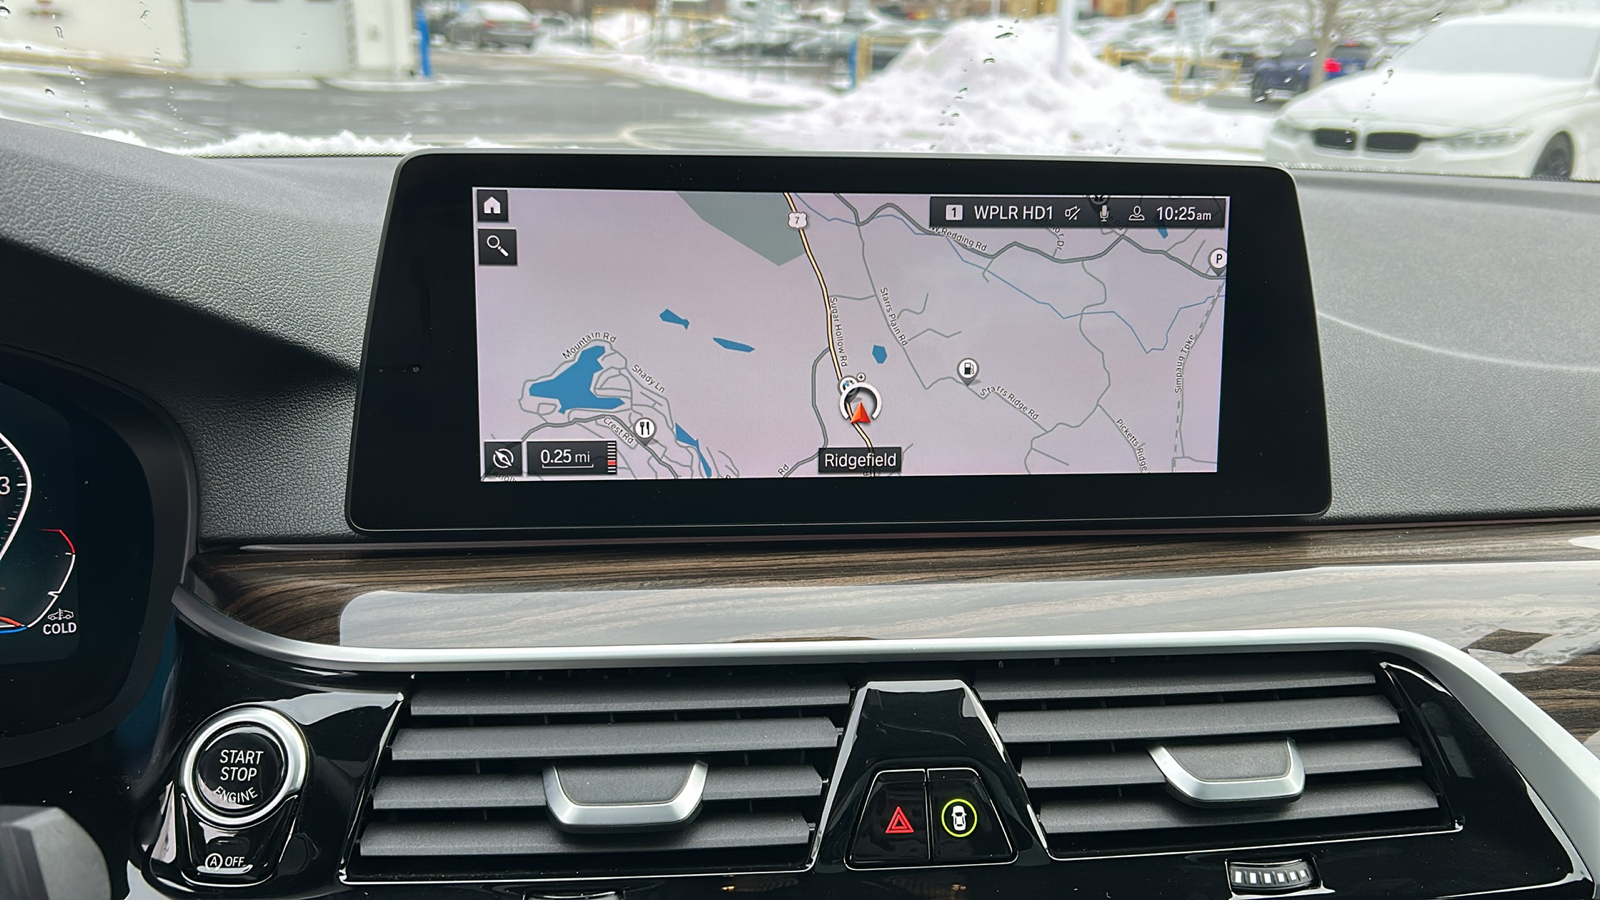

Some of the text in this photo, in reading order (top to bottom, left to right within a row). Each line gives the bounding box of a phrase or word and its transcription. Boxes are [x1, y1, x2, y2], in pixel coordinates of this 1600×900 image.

[794, 216, 800, 224] 7
[974, 205, 1053, 220] WPLR HD1
[941, 227, 974, 248] Redding
[975, 241, 988, 252] Rd
[880, 287, 908, 346] Starrs Plain Rd
[830, 297, 848, 367] Sugar Hollow Rd
[562, 332, 617, 359] Mountain Rd
[1174, 334, 1195, 394] Simpaug Tpke
[631, 364, 666, 393] Shady Ln
[979, 385, 1039, 420] Starrs Ridge Rd
[603, 416, 634, 444] Crest Rd
[1116, 418, 1148, 471] Picketts Ridge
[540, 449, 590, 464] 0.25 mi
[824, 453, 897, 470] Ridgefield
[777, 463, 790, 476] Rd
[42, 622, 77, 635] COLD
[220, 749, 264, 765] START
[220, 766, 258, 782] STOP
[214, 786, 259, 803] ENGINE
[224, 856, 246, 867] OFF
